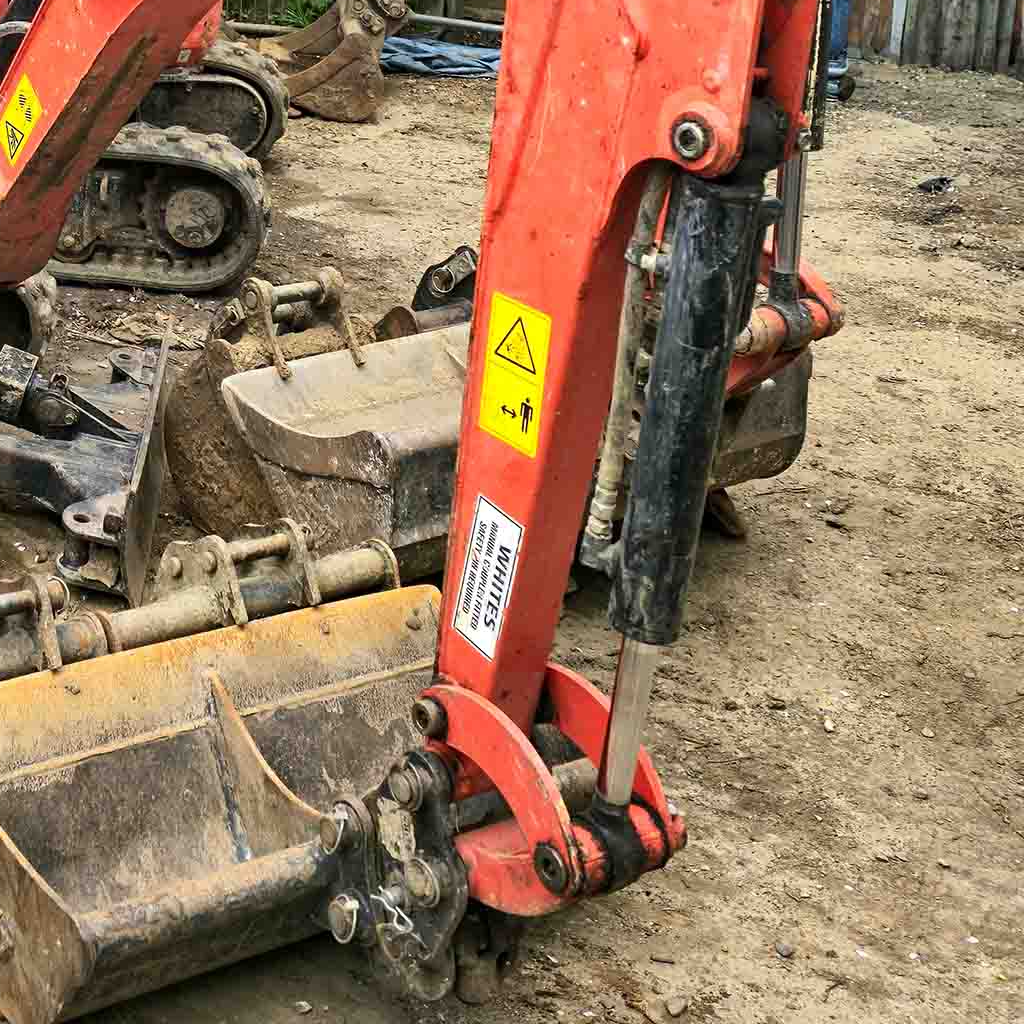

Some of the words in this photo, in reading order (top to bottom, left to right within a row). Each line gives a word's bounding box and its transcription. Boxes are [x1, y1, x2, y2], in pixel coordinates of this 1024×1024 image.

[474, 520, 487, 555] SAFETY
[485, 521, 499, 560] MANUAL
[463, 570, 477, 615] REQUIRED
[483, 544, 512, 632] WHITES
[470, 599, 482, 631] FITTED
